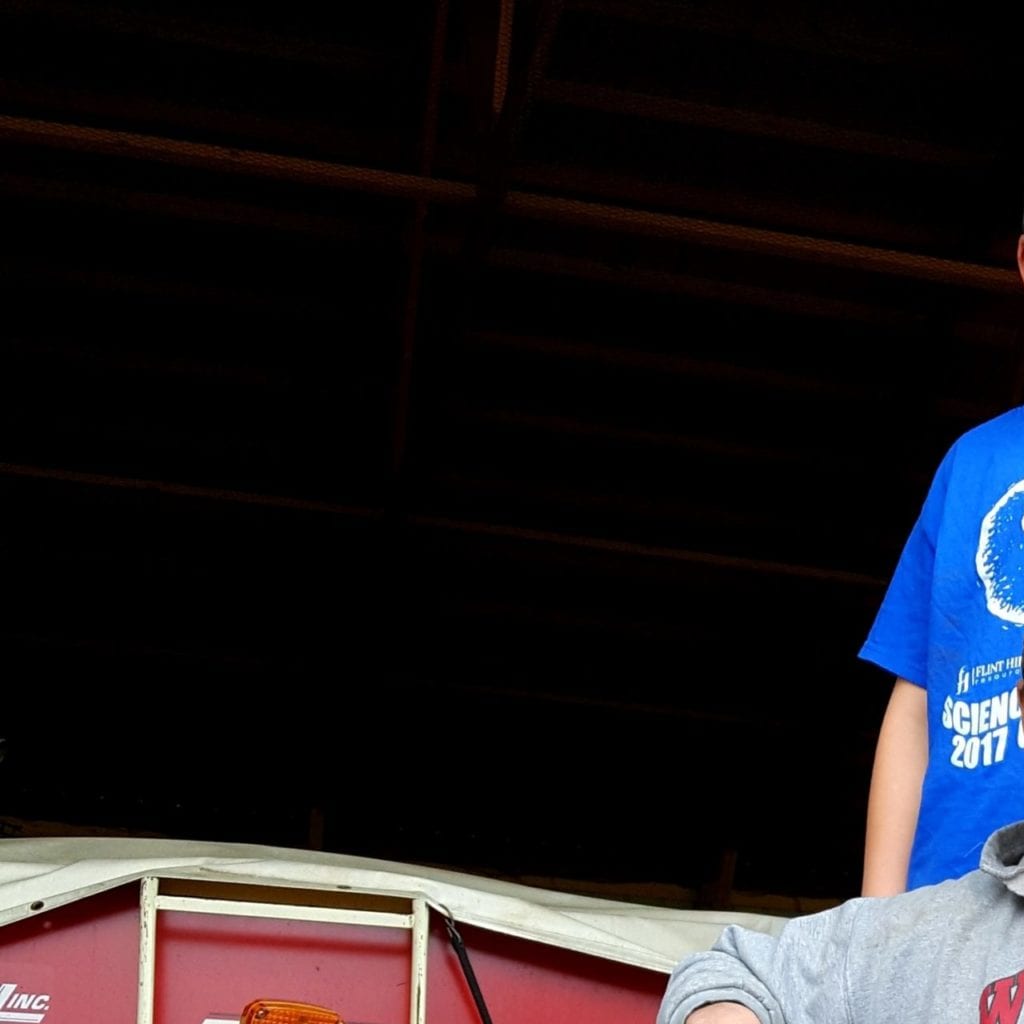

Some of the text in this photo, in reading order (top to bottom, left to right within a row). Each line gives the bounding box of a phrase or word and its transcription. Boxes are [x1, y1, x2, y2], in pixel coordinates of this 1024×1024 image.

[976, 660, 1005, 677] FLINT
[950, 726, 1008, 769] 2017
[6, 993, 50, 1010] INC.
